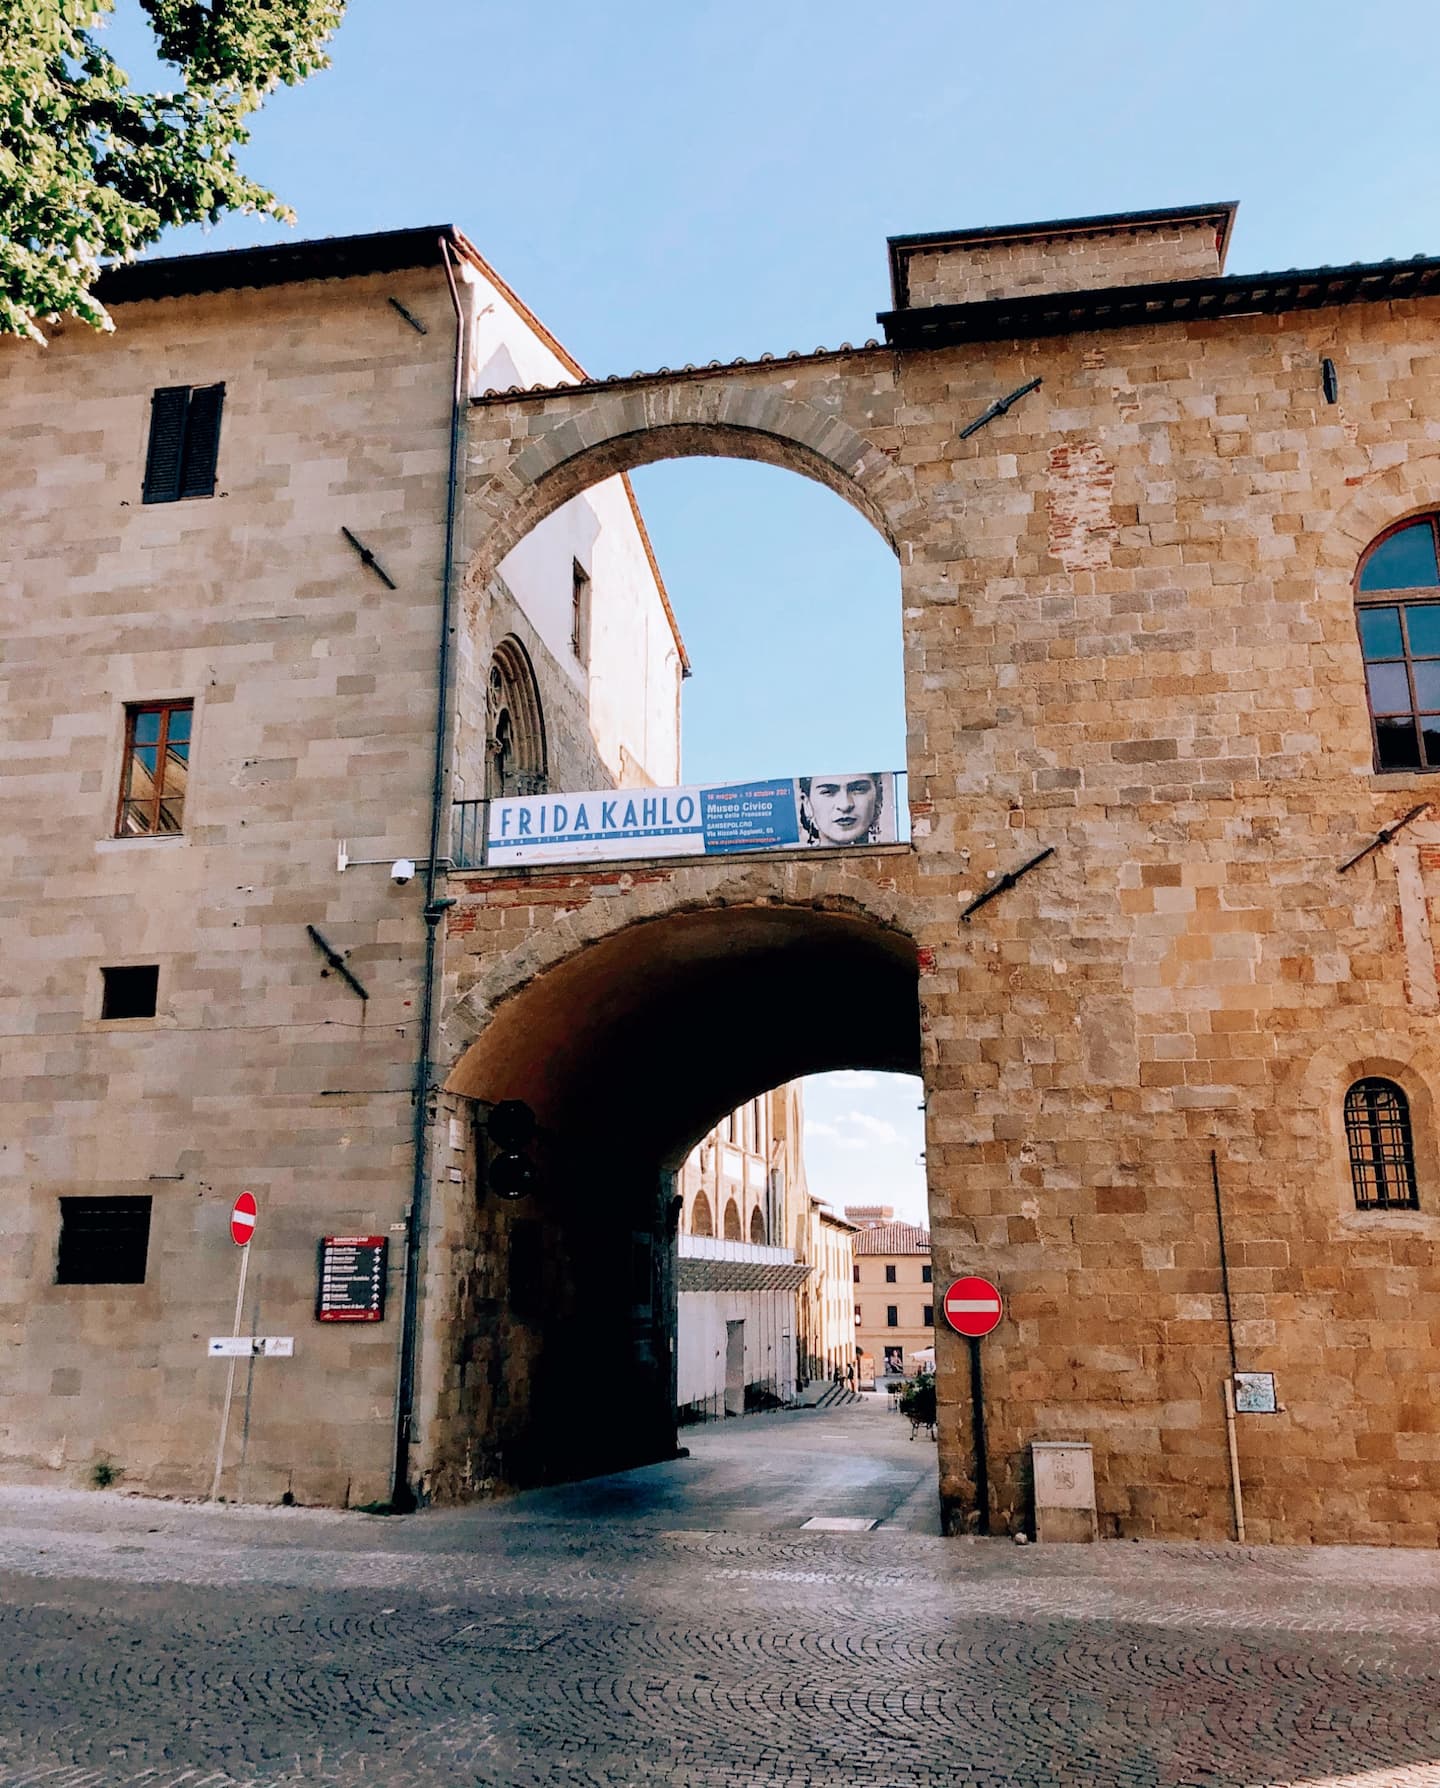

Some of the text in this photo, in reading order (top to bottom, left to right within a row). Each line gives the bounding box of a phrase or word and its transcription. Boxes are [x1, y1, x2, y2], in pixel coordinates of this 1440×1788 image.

[501, 796, 695, 836] FRIDA KAHLO
[707, 802, 773, 814] Museo Civico
